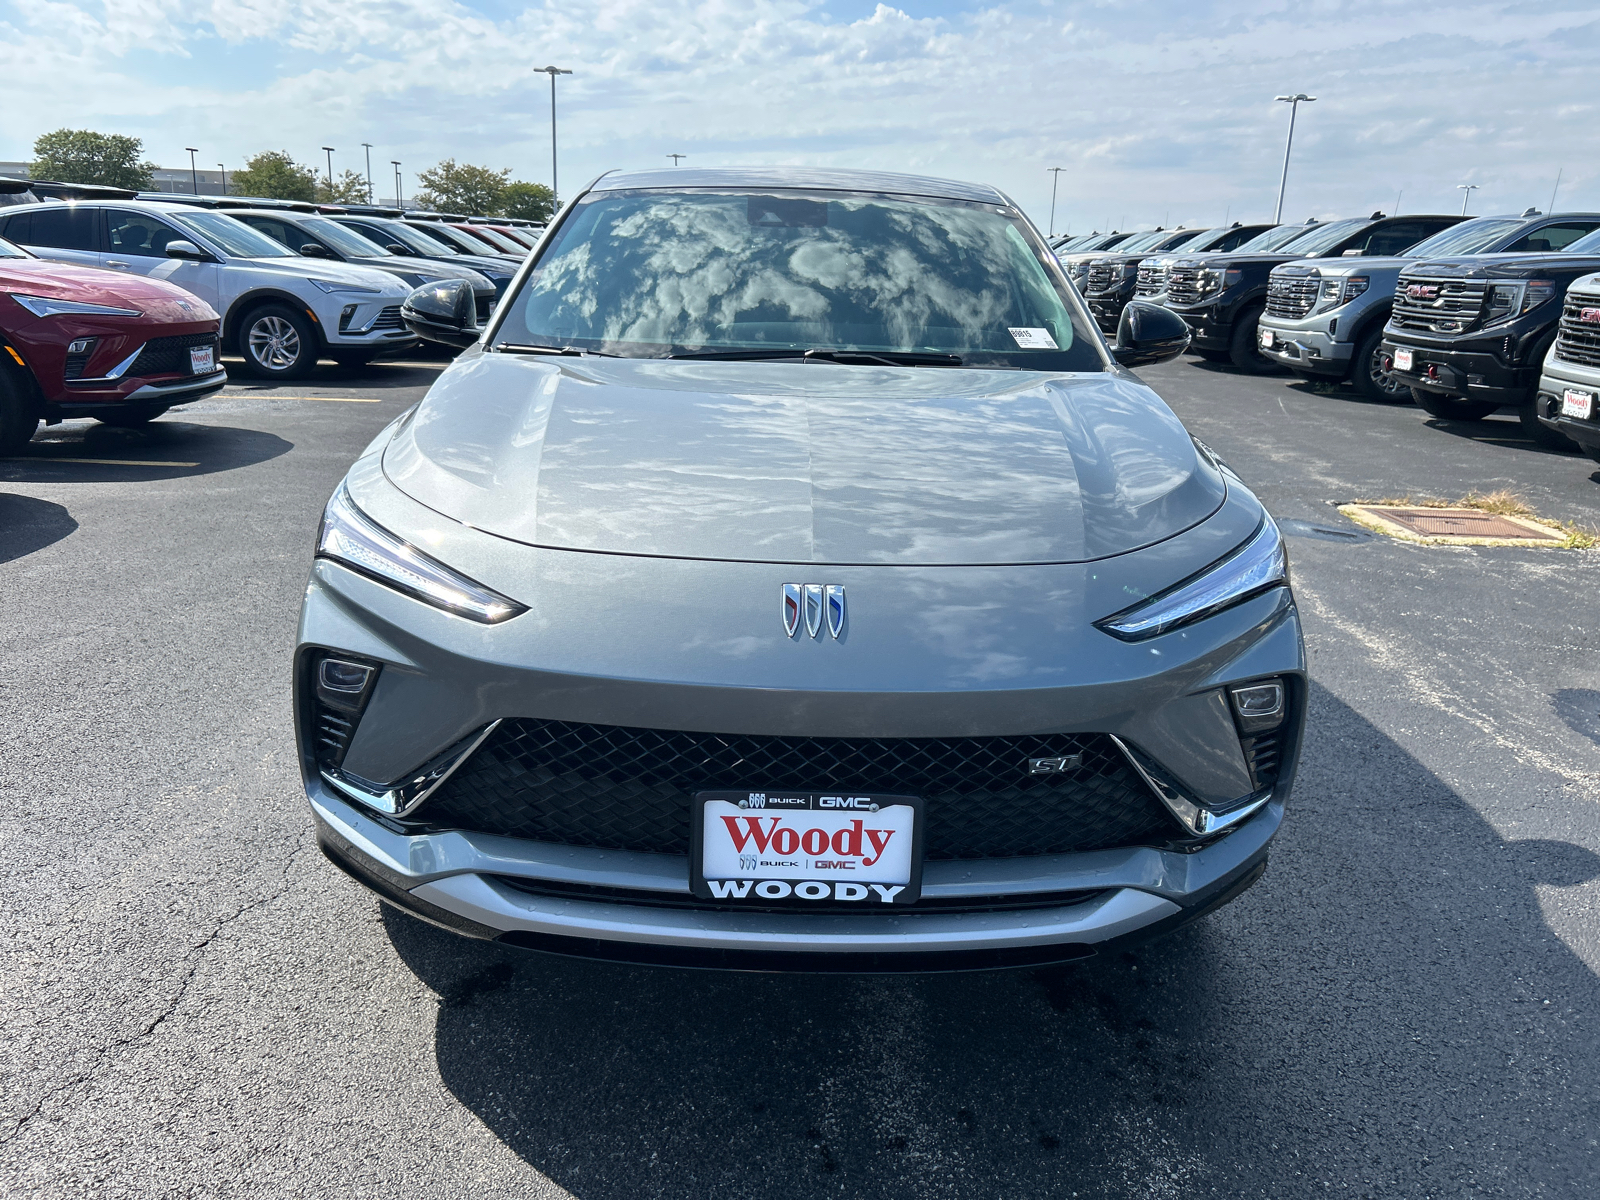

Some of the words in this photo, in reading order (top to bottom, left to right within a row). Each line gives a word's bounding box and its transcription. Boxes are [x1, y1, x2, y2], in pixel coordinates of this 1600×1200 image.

[1406, 285, 1438, 298] GMC
[1567, 394, 1588, 409] Woody
[819, 796, 870, 808] GMC
[720, 815, 895, 866] Woody
[815, 860, 856, 869] GMC
[707, 880, 906, 903] WOODY
